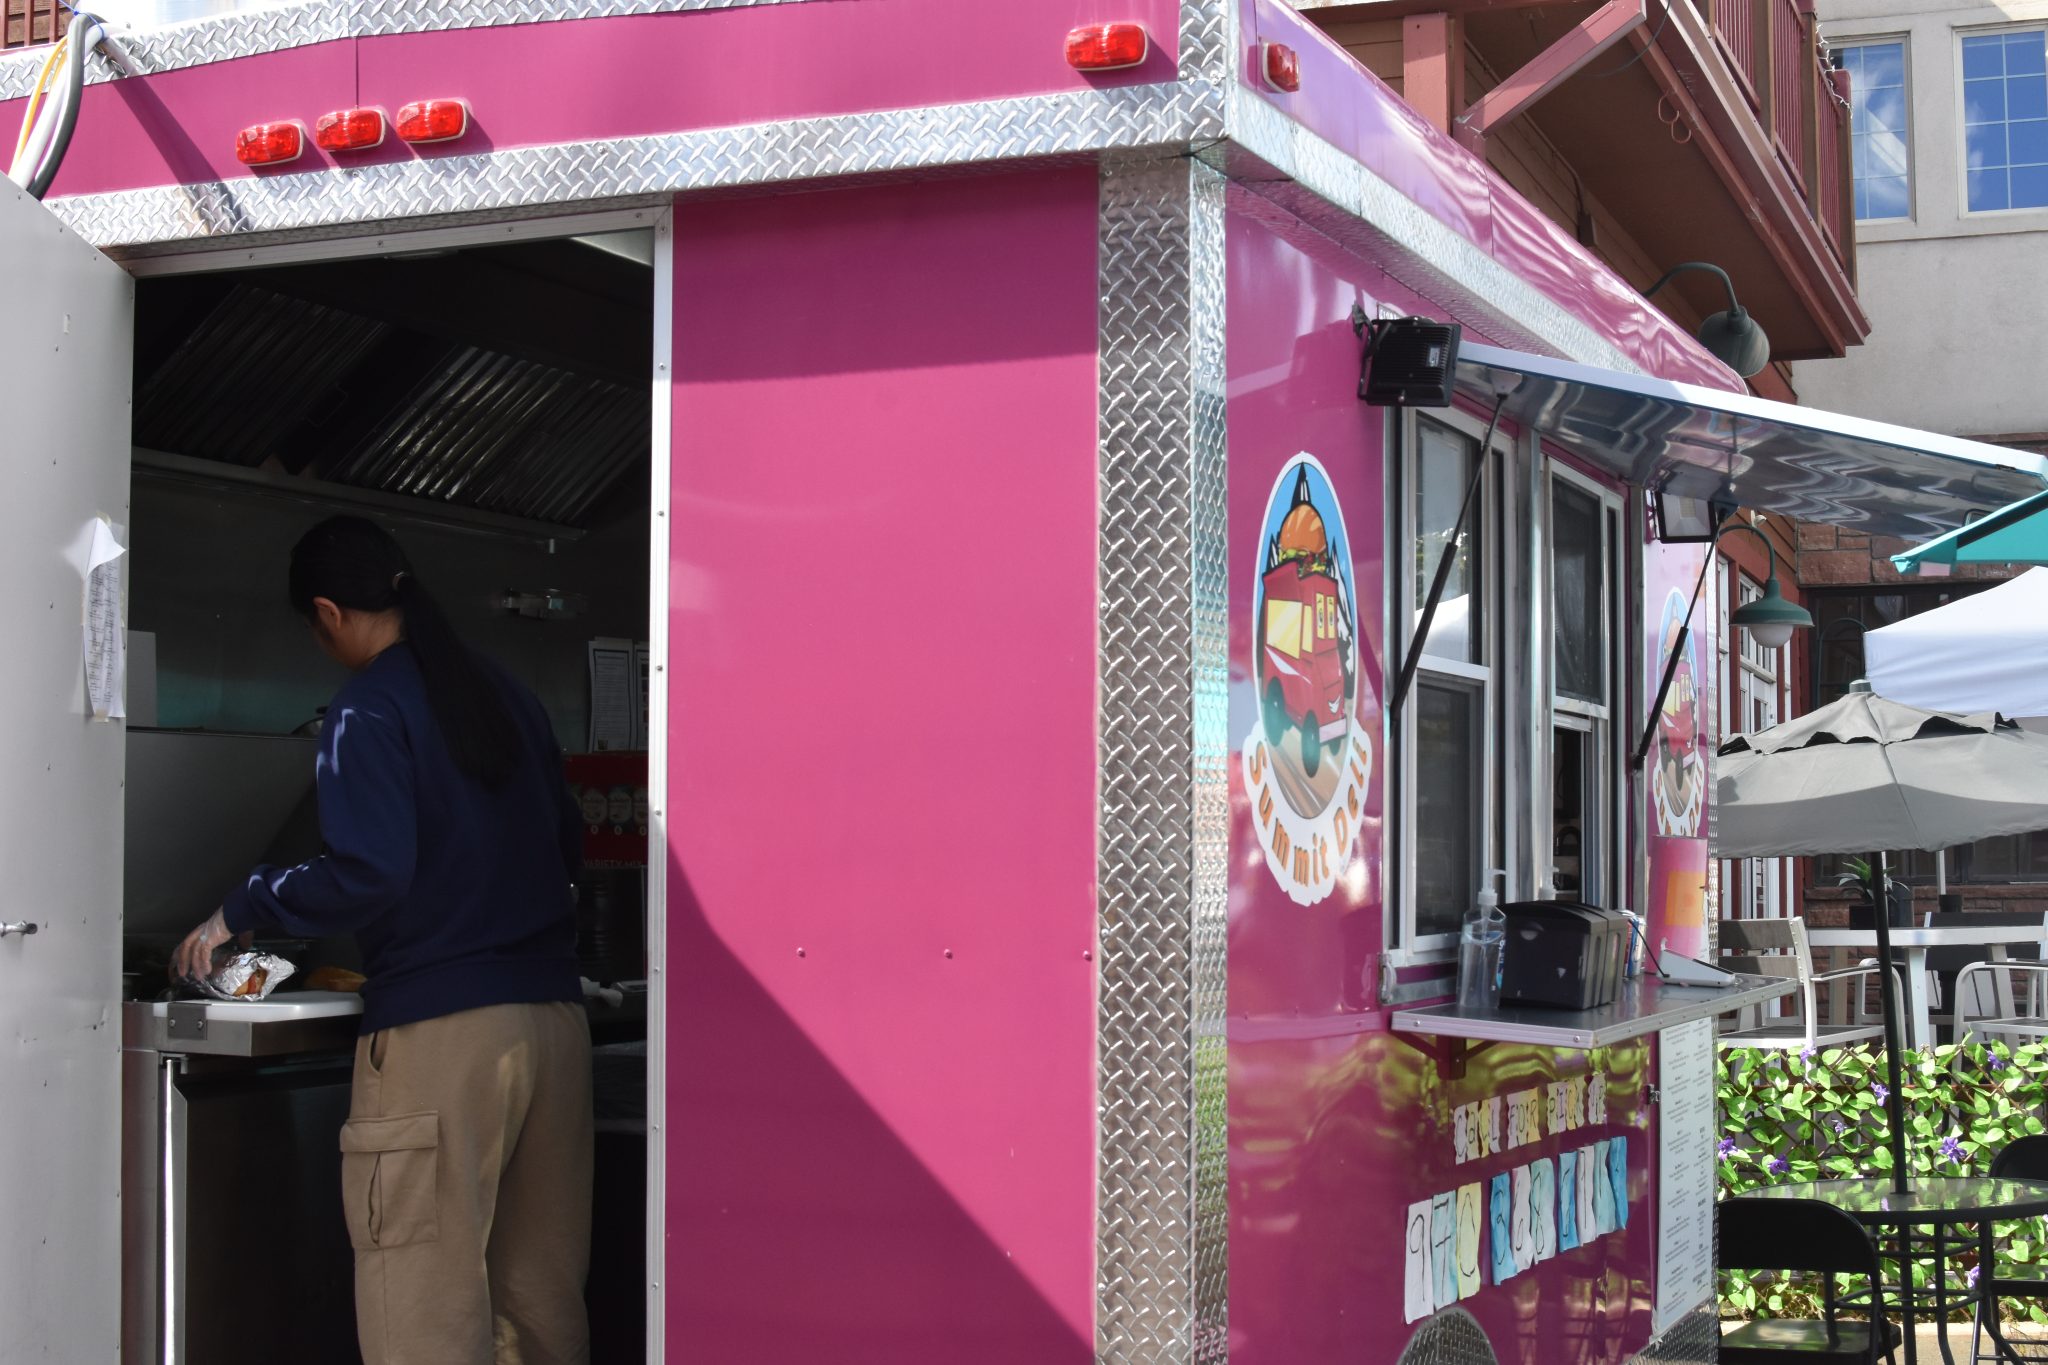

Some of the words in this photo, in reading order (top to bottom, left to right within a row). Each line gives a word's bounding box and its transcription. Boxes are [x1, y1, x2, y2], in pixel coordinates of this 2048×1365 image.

[1250, 741, 1330, 888] Summit
[1333, 737, 1367, 858] Deli
[1509, 1098, 1538, 1134] FOR
[1409, 1192, 1476, 1303] 970
